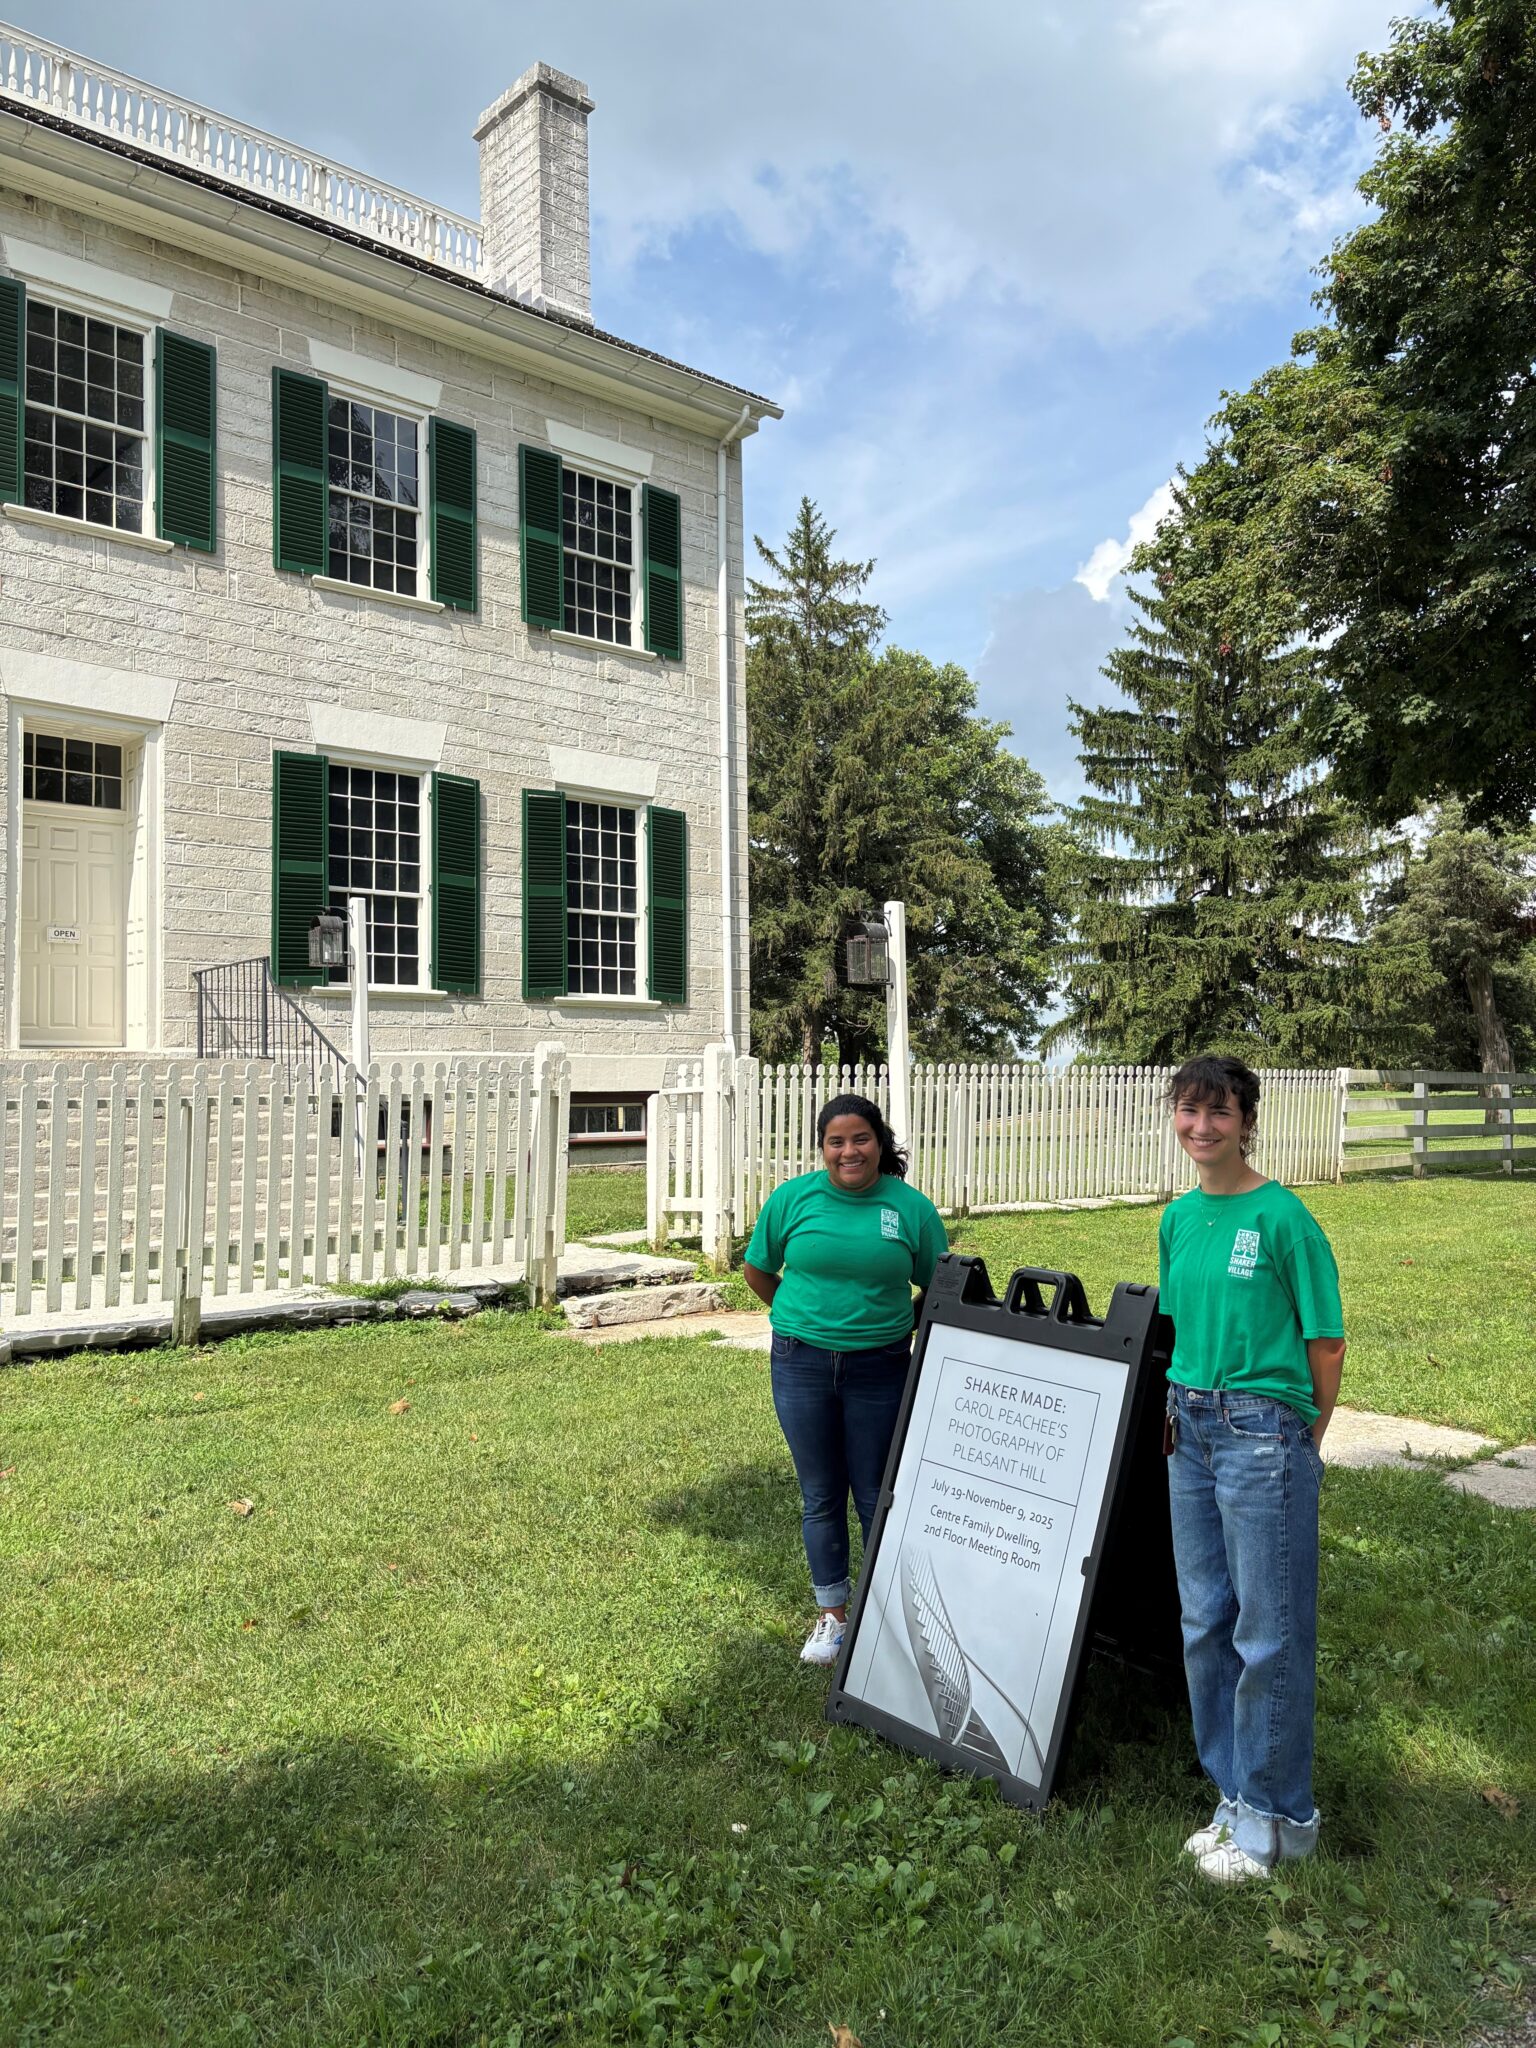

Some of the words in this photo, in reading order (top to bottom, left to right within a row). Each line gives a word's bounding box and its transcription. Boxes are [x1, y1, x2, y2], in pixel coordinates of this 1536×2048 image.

[1228, 1266, 1254, 1277] VILLAGE
[1230, 1257, 1256, 1268] SHAKER
[964, 1376, 1018, 1401] SHAKER
[1020, 1390, 1067, 1414] MADE:
[954, 1397, 995, 1420] CAROL
[998, 1408, 1068, 1439] PEACHEE'S
[948, 1418, 1044, 1456] PHOTOGRAPHY
[1045, 1445, 1066, 1462] OF
[953, 1443, 1018, 1474] PLEASANT
[1019, 1463, 1047, 1484] HILL
[931, 1478, 950, 1496] July
[951, 1487, 1017, 1515] 19-November
[1017, 1508, 1026, 1521] 9,
[1029, 1512, 1054, 1530] 2025
[923, 1524, 942, 1537] 2nd
[942, 1528, 967, 1546] Floor
[968, 1537, 1009, 1564] Meeting
[1010, 1551, 1041, 1572] Room
[930, 1504, 960, 1524] Centre
[962, 1515, 995, 1538] Family
[995, 1526, 1041, 1555] Dwelling,
